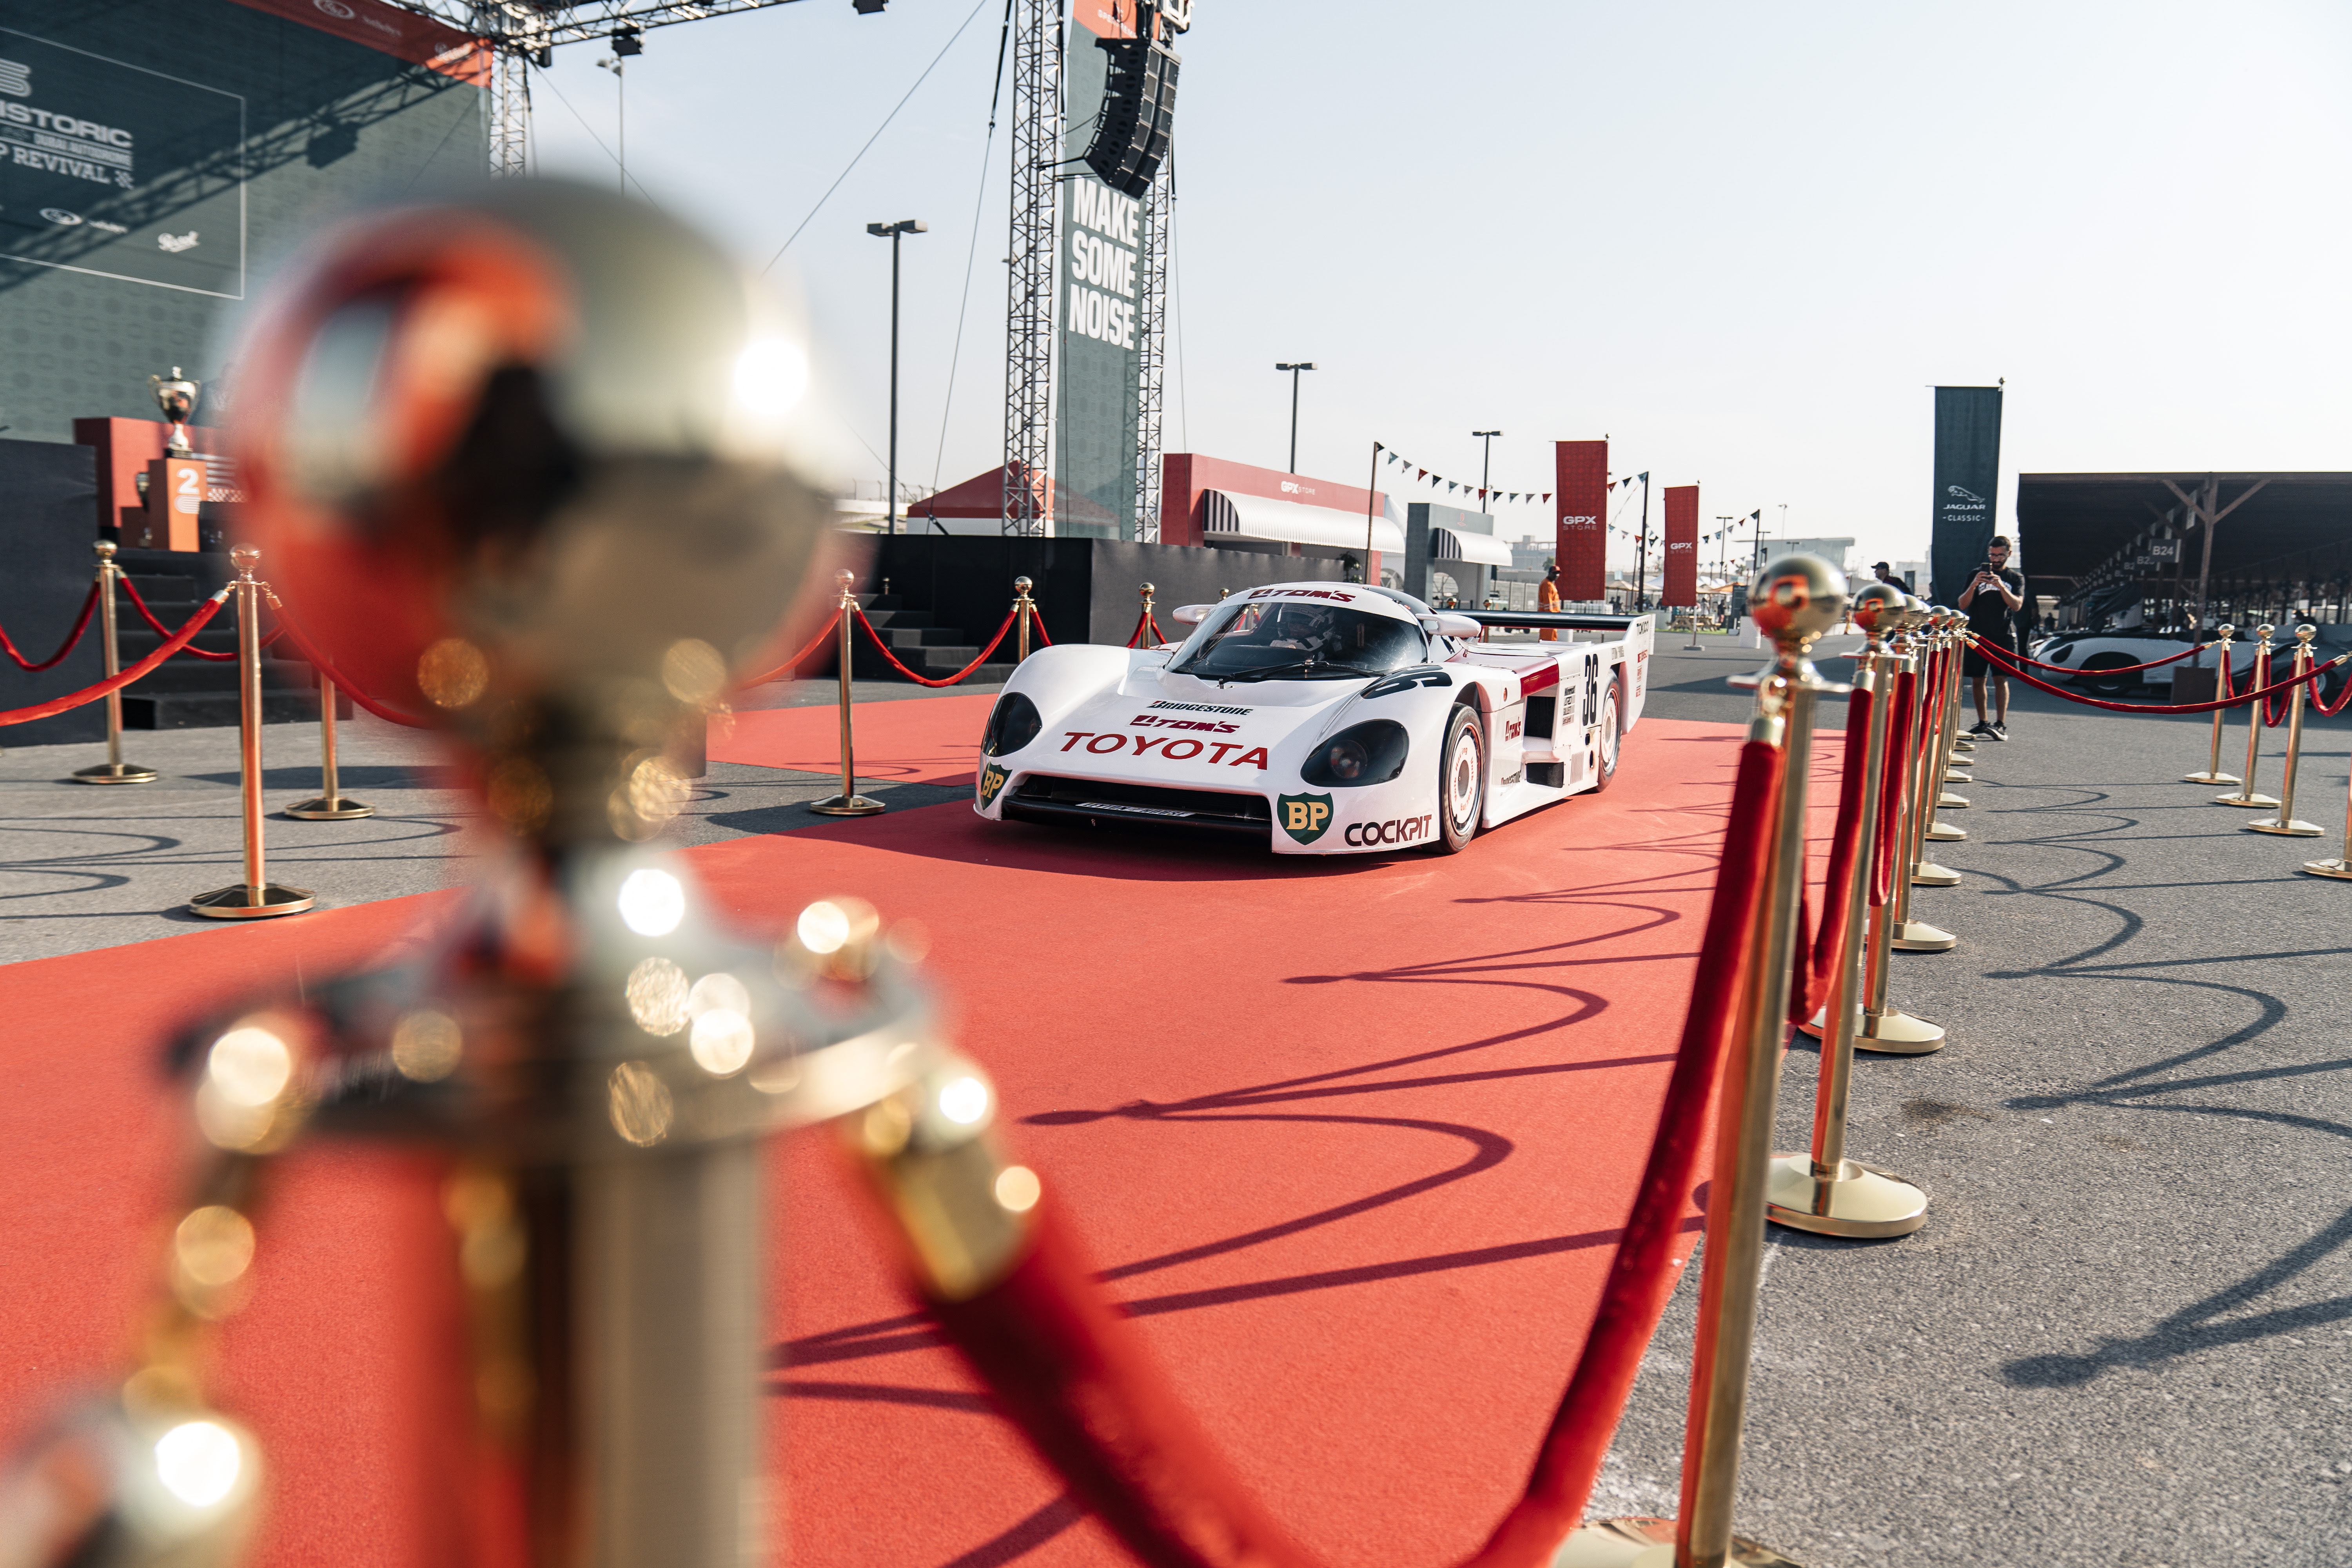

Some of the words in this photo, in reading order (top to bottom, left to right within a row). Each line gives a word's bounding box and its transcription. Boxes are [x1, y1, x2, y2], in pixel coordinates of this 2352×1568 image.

[0, 100, 133, 148] ISTORIC
[13, 146, 110, 184] REVIVAL
[1073, 174, 1140, 248] MAKE
[1071, 230, 1137, 299] SOME
[1069, 283, 1135, 350] NOISE
[178, 468, 199, 494] 2
[1281, 481, 1299, 494] GPX
[1563, 516, 1597, 524] GPX
[2137, 556, 2155, 564] B2
[2152, 546, 2174, 555] B24
[1270, 589, 1356, 603] TOM'S
[1583, 653, 1598, 726] 36
[1146, 701, 1254, 715] BRIDGESTONE
[1152, 719, 1241, 733] TOM'S
[1060, 732, 1268, 771] TOYOTA
[981, 770, 1004, 799] BP
[1285, 802, 1329, 831] BP
[1345, 815, 1432, 847] COCKPIT
